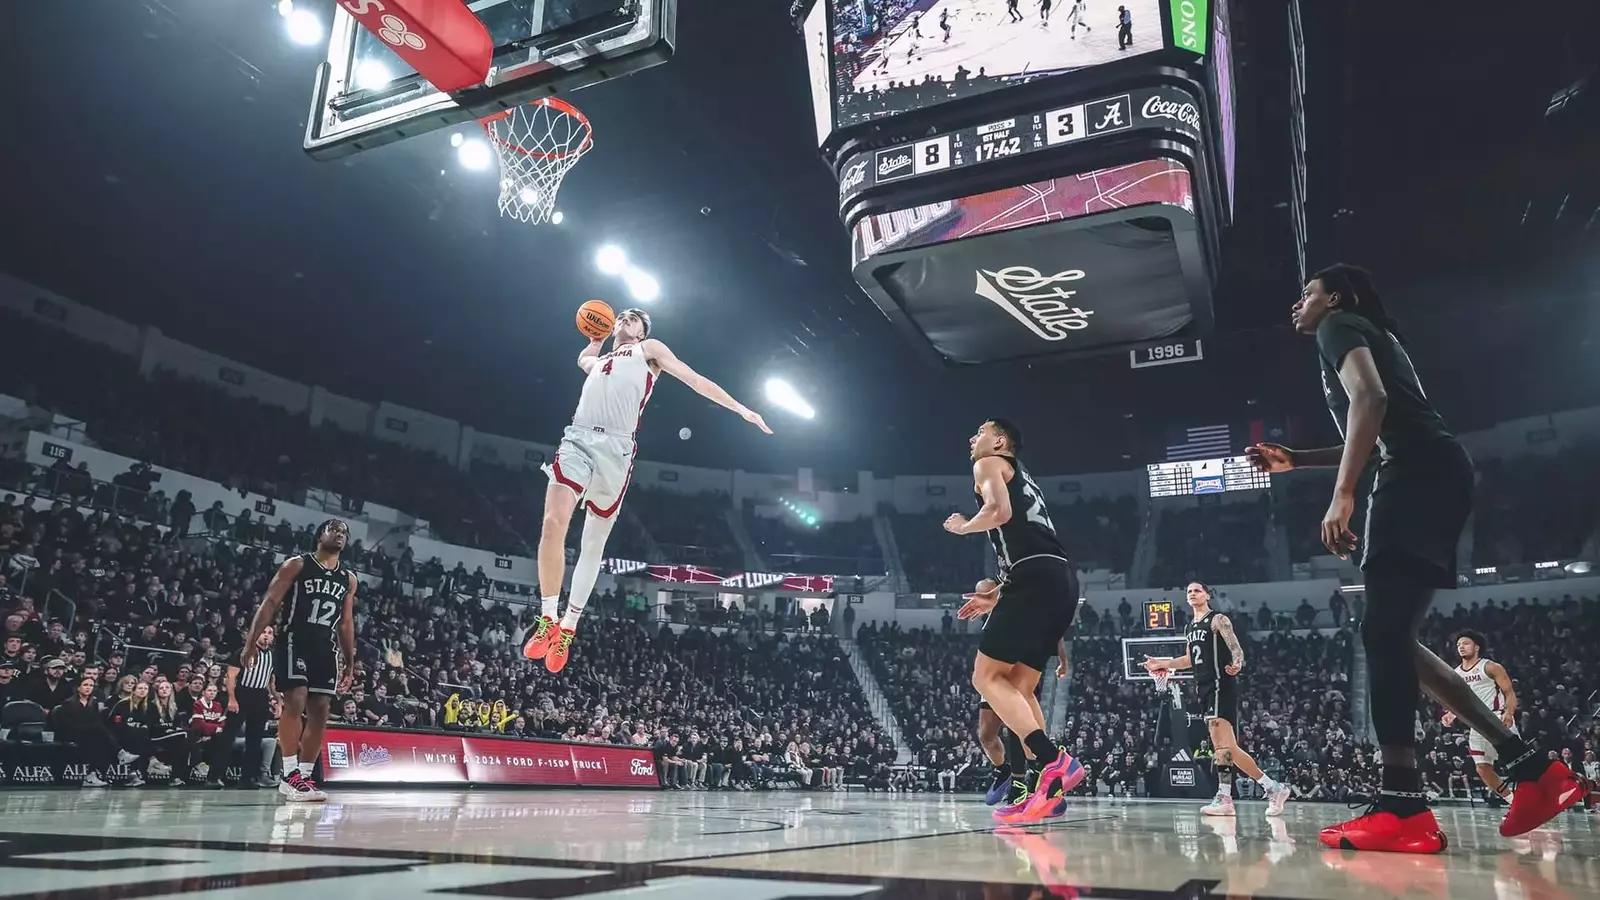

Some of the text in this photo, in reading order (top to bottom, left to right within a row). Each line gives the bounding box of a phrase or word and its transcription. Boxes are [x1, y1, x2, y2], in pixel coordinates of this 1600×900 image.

[1057, 112, 1074, 137] 3
[925, 143, 940, 166] 8
[975, 136, 1021, 162] 17:42
[878, 154, 912, 176] State
[975, 265, 1095, 342] State
[586, 311, 610, 330] Wilson
[1147, 343, 1185, 361] 1996
[601, 358, 614, 376] 4
[49, 445, 66, 458] 116
[304, 578, 347, 600] STATE
[307, 598, 337, 627] 12
[1149, 602, 1171, 613] 17:42
[1149, 612, 1169, 627] 21
[1192, 644, 1204, 665] 2
[424, 753, 457, 765] WITH
[463, 756, 470, 764] A
[475, 755, 501, 765] 2024
[506, 756, 533, 767] FORD
[573, 759, 602, 770] TRUCK
[630, 758, 655, 776] Ford
[13, 766, 54, 778] ALFA
